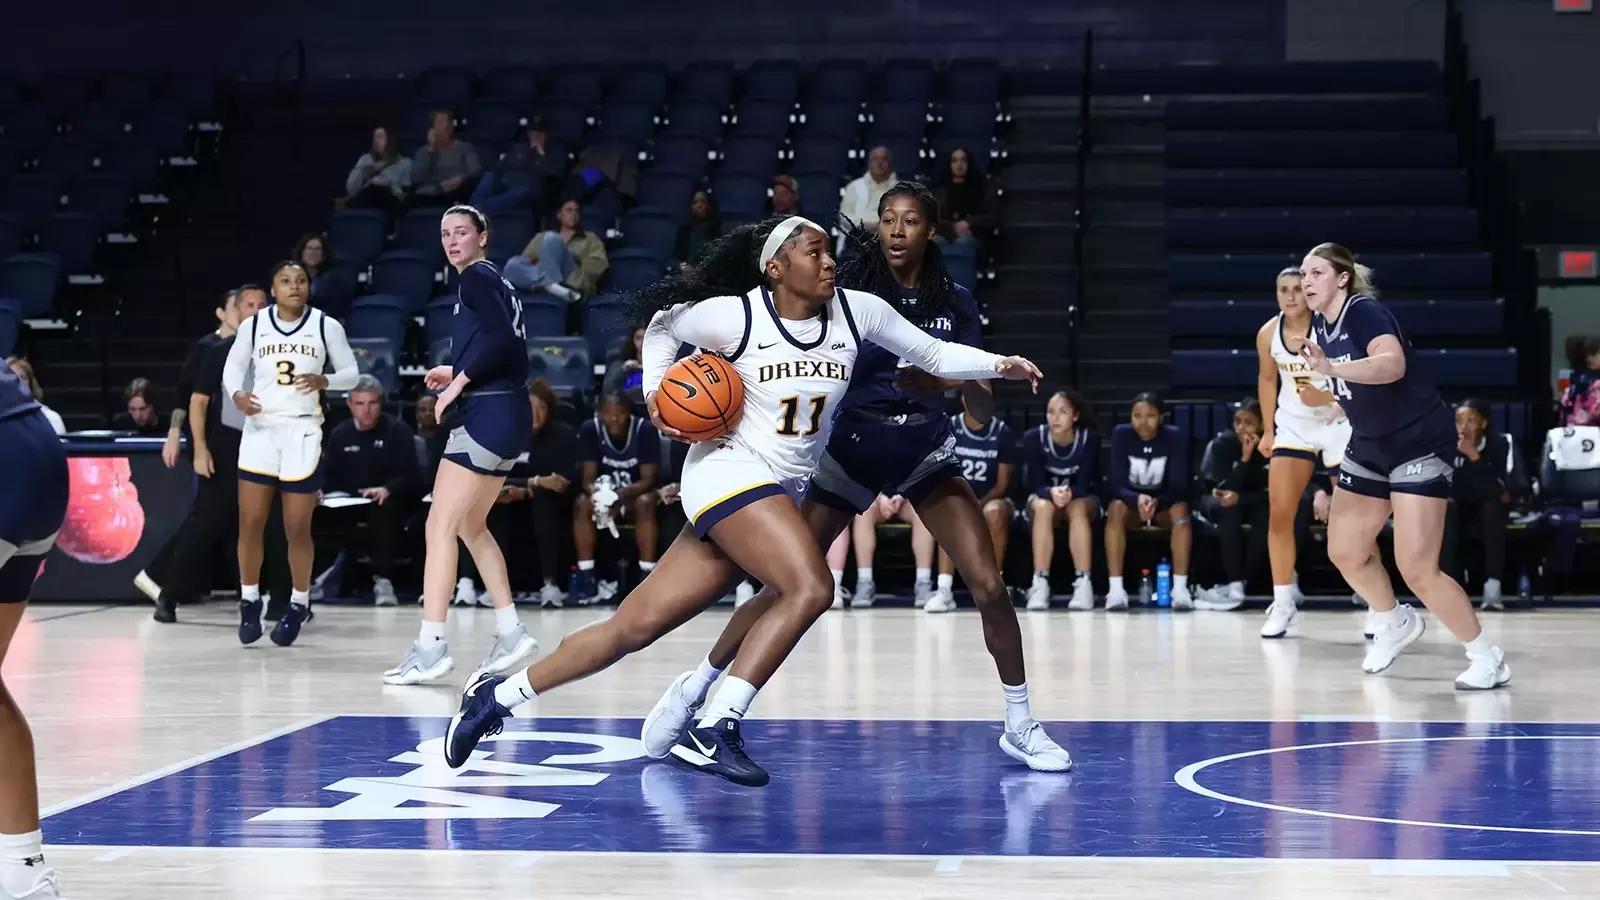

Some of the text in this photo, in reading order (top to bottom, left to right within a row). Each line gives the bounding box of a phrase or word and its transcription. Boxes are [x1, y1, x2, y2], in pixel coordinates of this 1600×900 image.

[259, 343, 318, 358] DREXEL
[276, 360, 296, 386] 3
[758, 360, 849, 383] DREXEL
[776, 394, 828, 437] 11
[961, 459, 987, 481] 22
[1127, 455, 1168, 489] M
[1406, 462, 1423, 475] M
